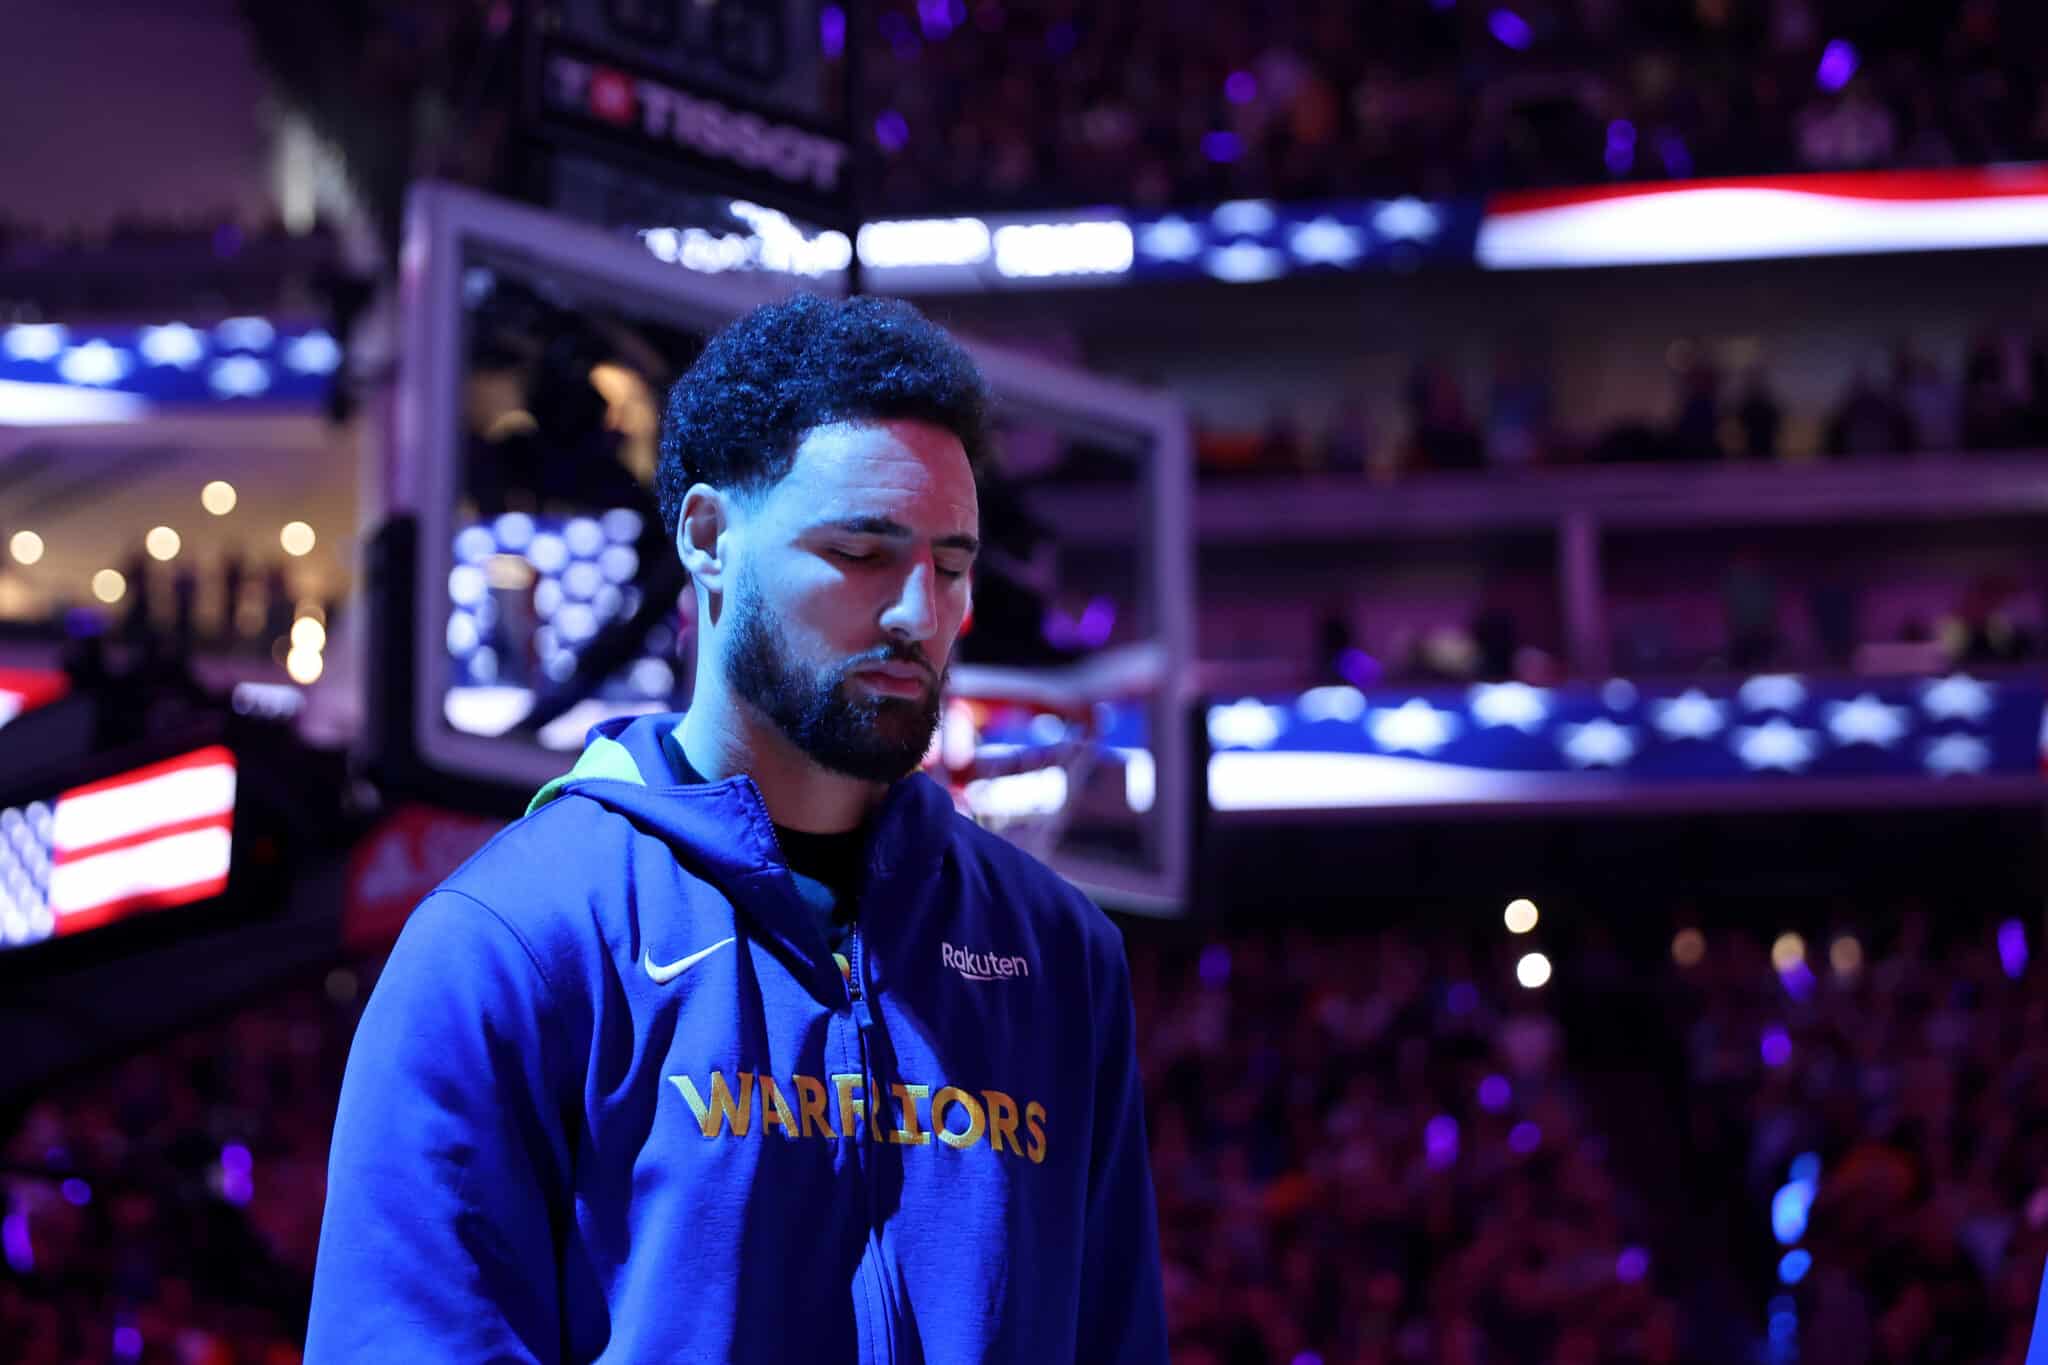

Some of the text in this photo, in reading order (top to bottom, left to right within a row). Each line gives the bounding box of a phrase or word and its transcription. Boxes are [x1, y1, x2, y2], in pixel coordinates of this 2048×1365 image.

[638, 80, 848, 190] TISSOT
[941, 941, 1030, 981] Rakuten
[668, 1070, 1048, 1165] WARRIORS
